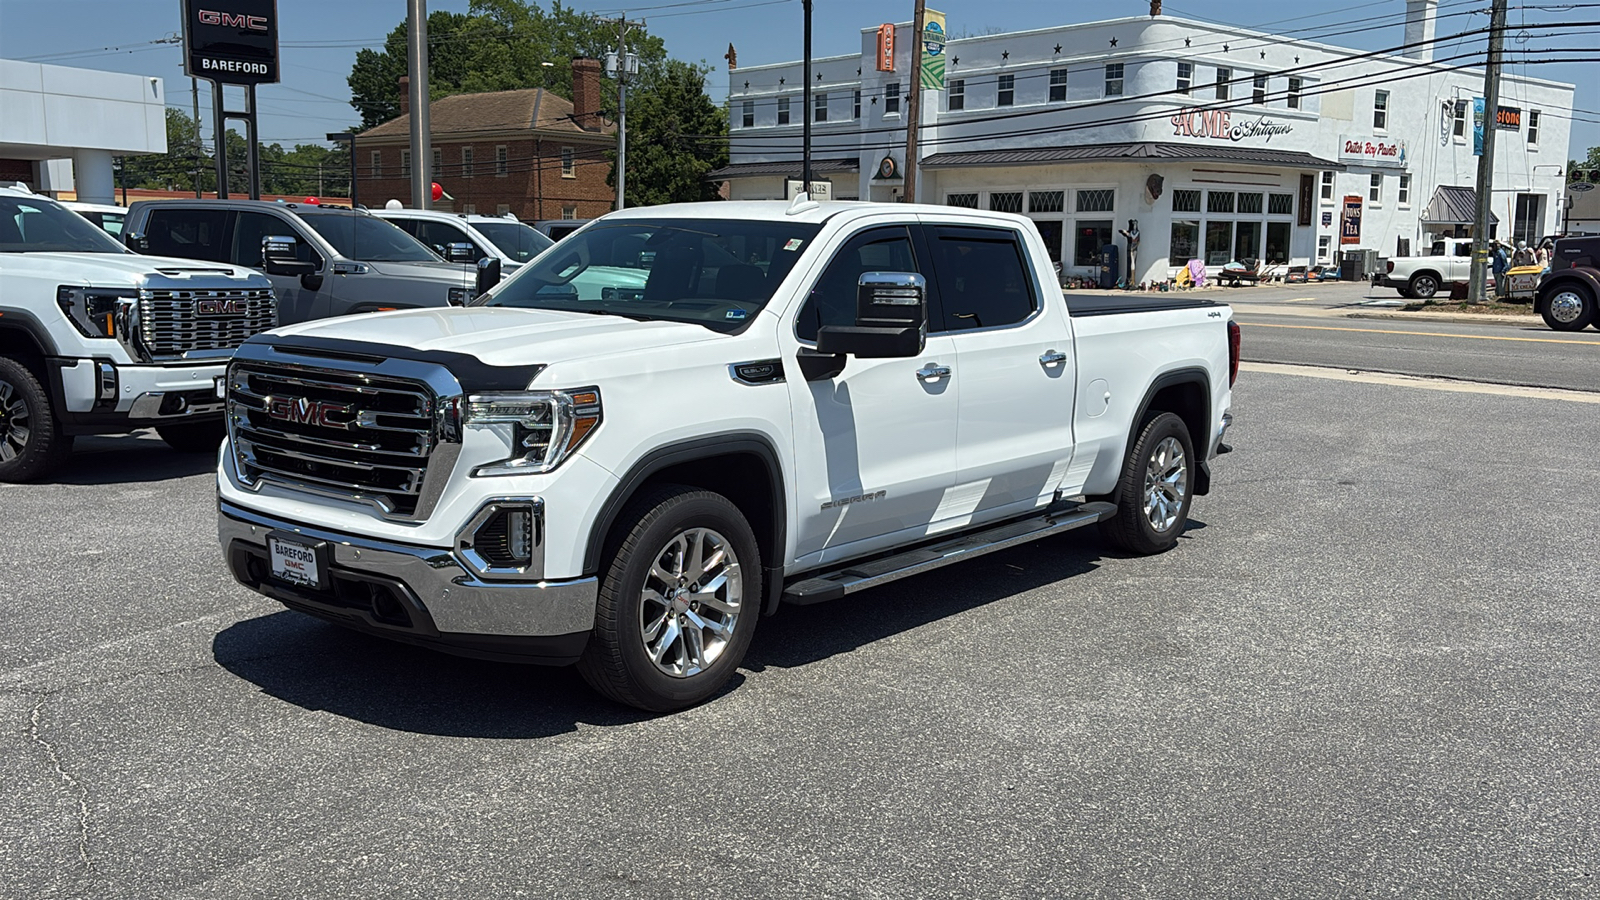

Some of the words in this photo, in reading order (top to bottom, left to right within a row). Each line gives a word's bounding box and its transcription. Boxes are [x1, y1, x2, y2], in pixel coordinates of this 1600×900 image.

[198, 9, 268, 31] GMC
[884, 27, 892, 69] ACME
[202, 58, 268, 75] BAREFORD
[1171, 107, 1231, 140] ACME
[1496, 109, 1520, 125] stone
[1344, 140, 1363, 154] Dutch
[1364, 141, 1377, 158] Boy
[1377, 142, 1398, 156] Paints
[1345, 223, 1358, 235] TEA
[200, 300, 248, 313] GMC
[268, 397, 349, 430] GMC
[820, 489, 887, 510] SIERRA
[275, 544, 314, 563] BAREFORD
[284, 559, 305, 571] GMC
